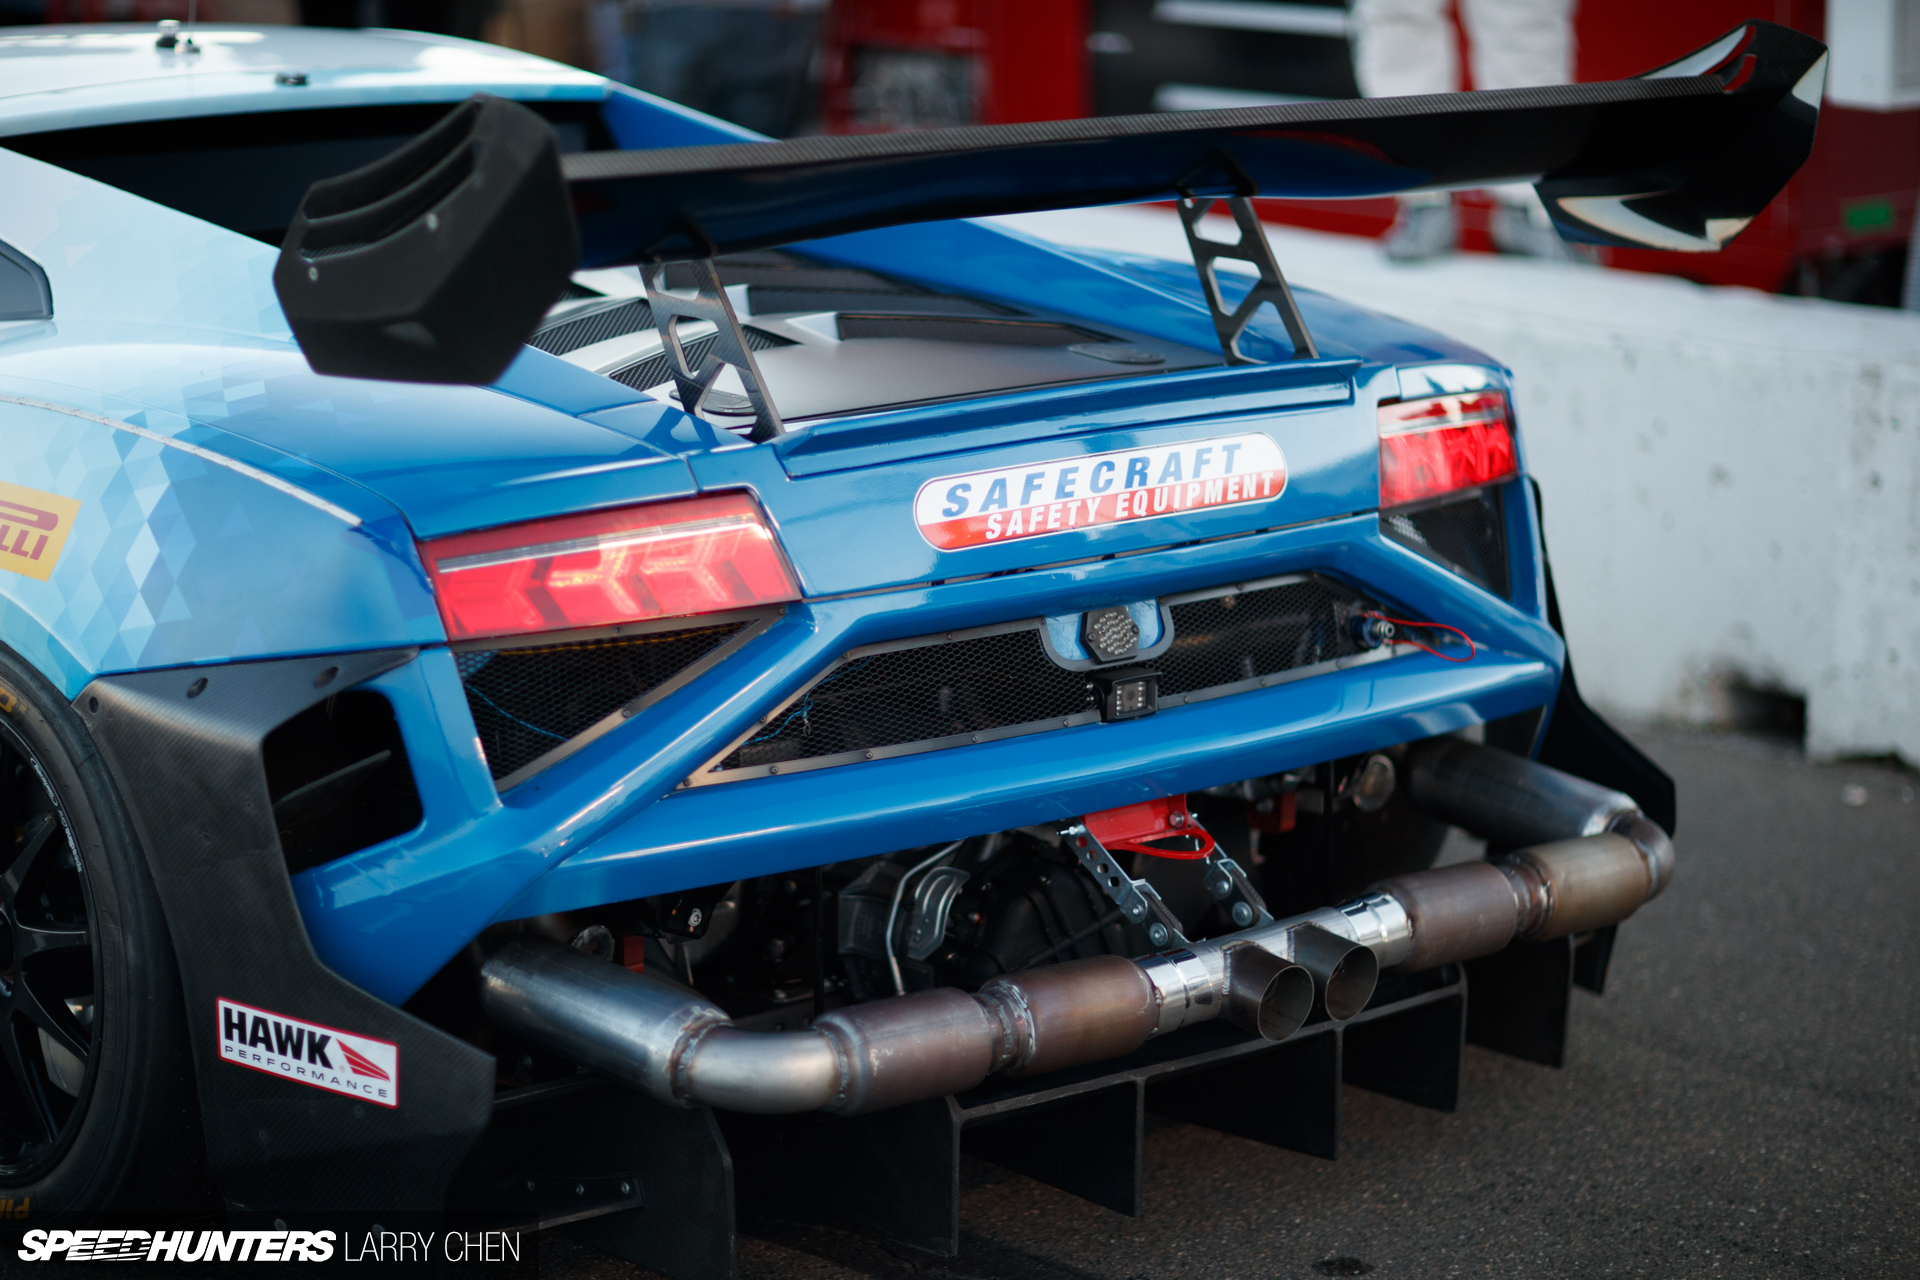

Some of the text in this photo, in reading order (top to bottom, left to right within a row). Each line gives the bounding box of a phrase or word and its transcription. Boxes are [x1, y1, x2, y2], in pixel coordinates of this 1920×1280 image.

[942, 443, 1241, 518] SAFECRAFT
[985, 471, 1275, 540] SAFETY EQUIPMENT
[65, 827, 82, 873] speedline
[223, 1006, 334, 1070] HAWK
[224, 1045, 388, 1099] PERFORMANCE
